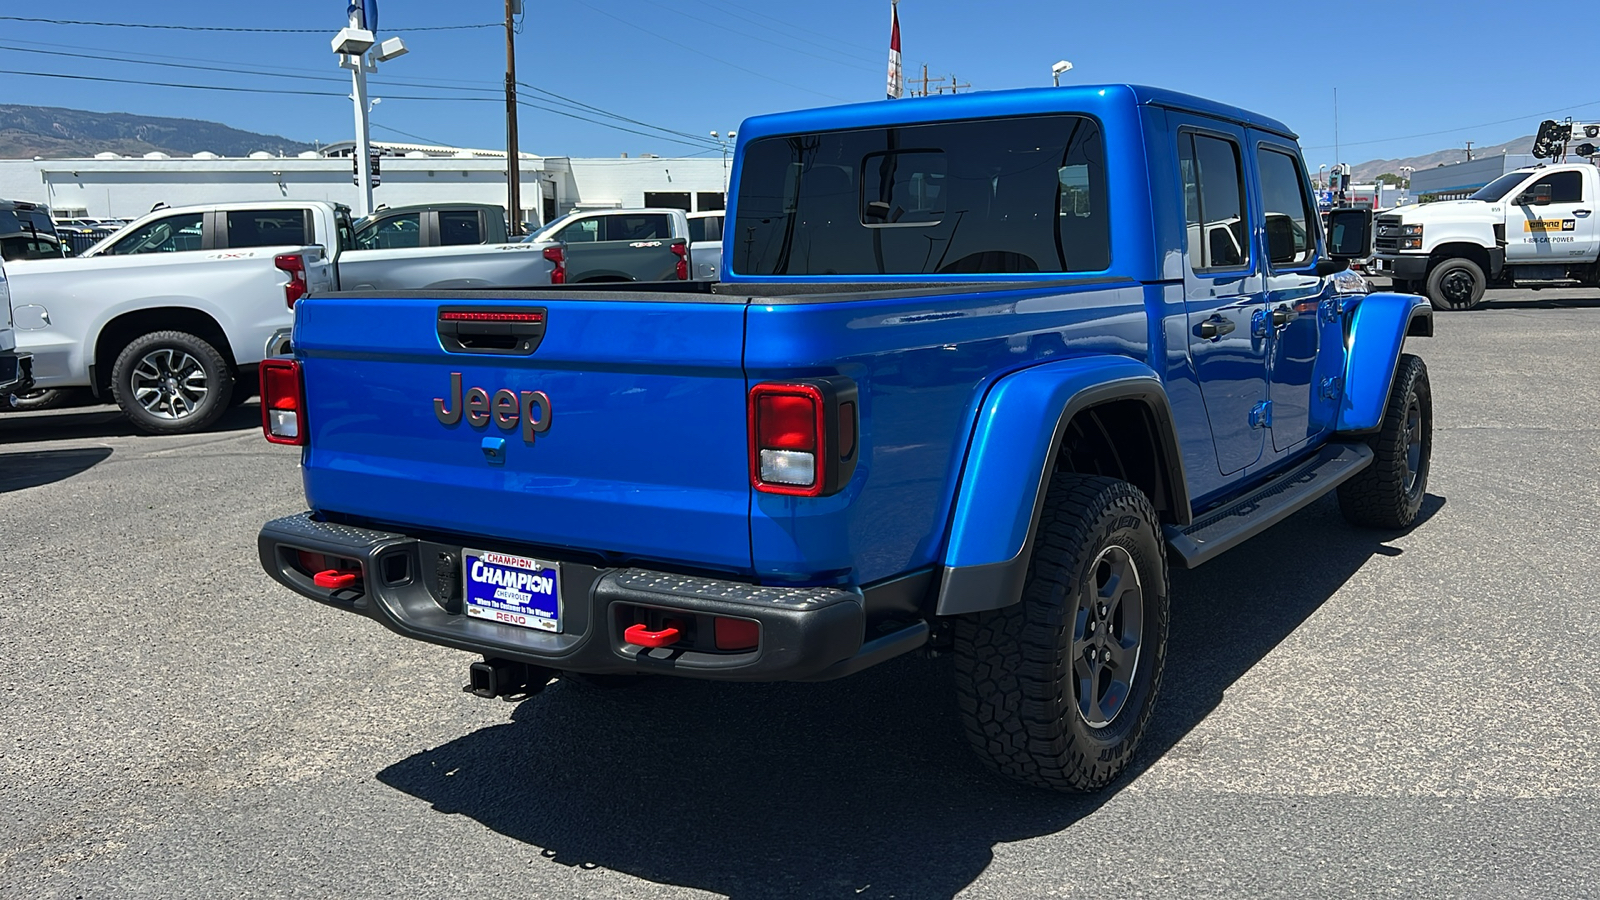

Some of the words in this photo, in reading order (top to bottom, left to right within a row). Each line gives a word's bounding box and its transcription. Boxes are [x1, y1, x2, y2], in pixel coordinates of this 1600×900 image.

[433, 372, 552, 443] Jeep
[487, 553, 532, 569] CHAMPION
[471, 560, 554, 595] CHAMPION
[496, 589, 529, 602] CHEVROLET
[491, 600, 499, 608] The
[526, 606, 534, 615] The
[496, 612, 526, 625] RENO
